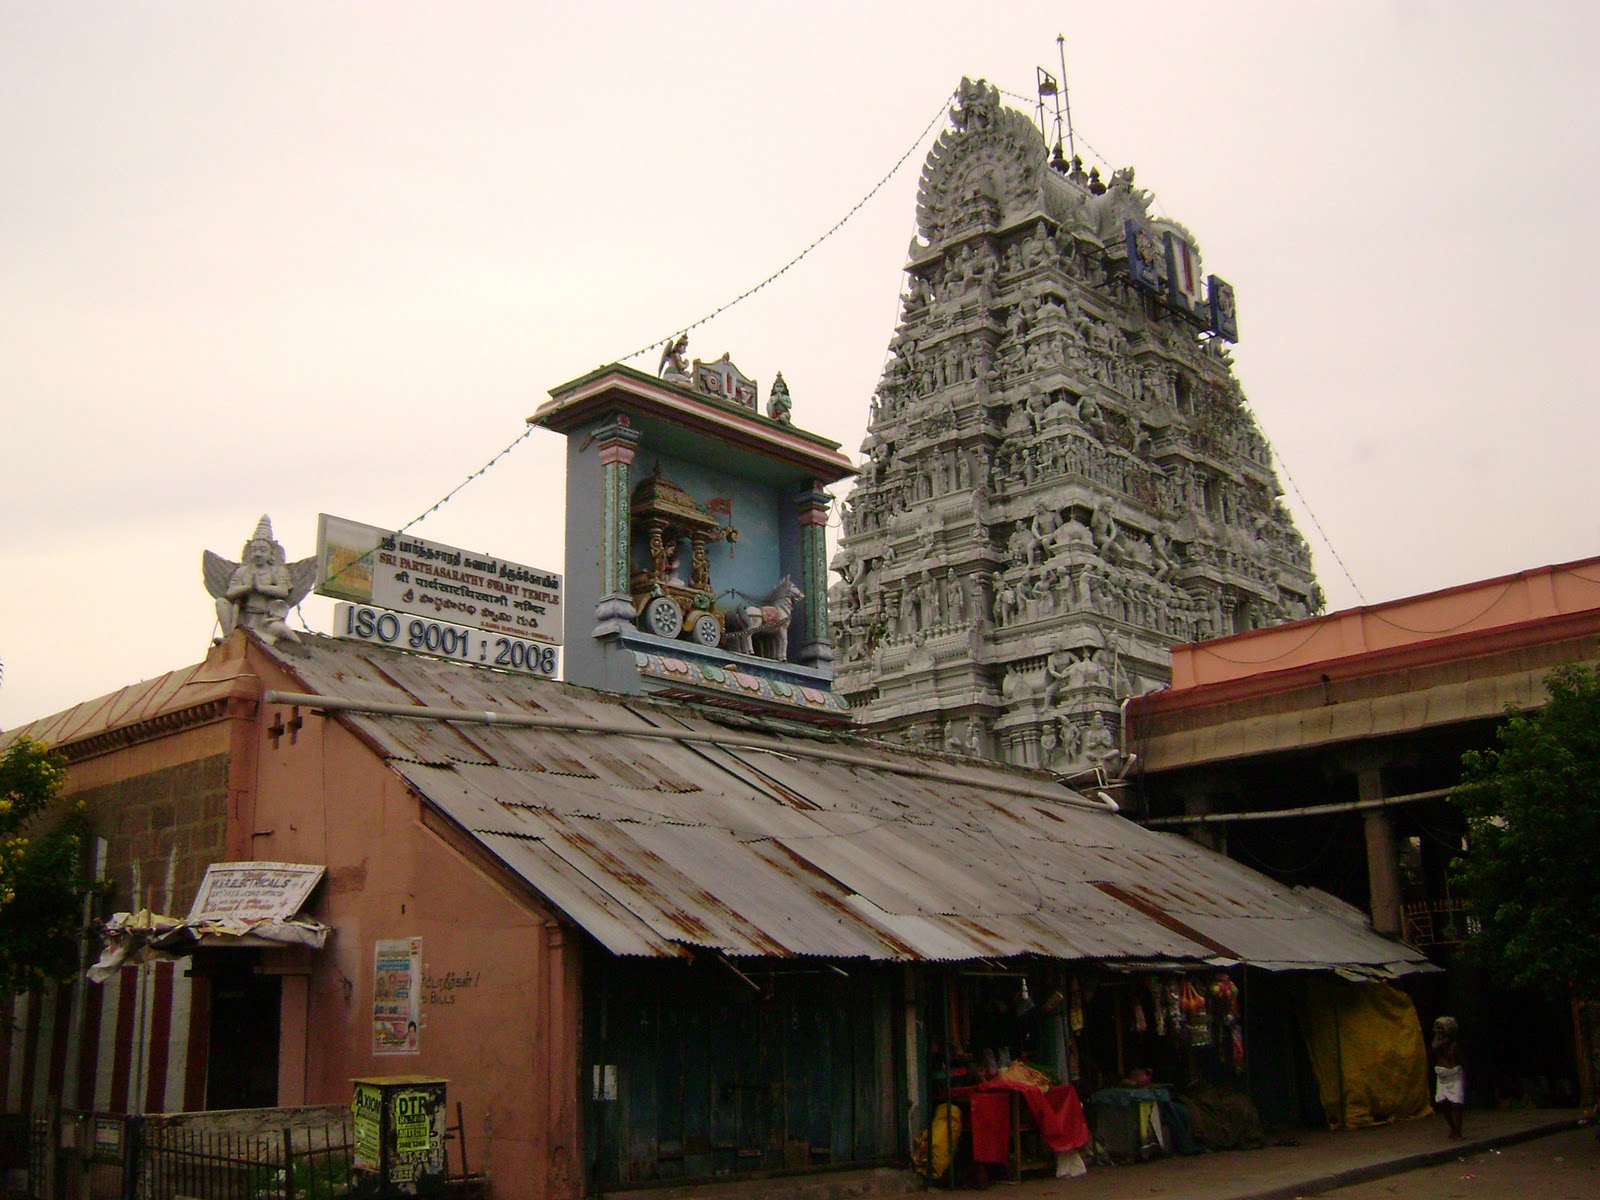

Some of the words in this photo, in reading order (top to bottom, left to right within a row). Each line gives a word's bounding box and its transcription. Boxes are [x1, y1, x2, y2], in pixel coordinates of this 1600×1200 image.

[379, 552, 397, 566] SRI
[399, 557, 485, 587] PARTHASARATHY
[487, 578, 520, 596] SWAMY
[521, 588, 559, 605] TEMPLE
[347, 605, 400, 642] ISO
[409, 619, 469, 658] 9001
[495, 638, 556, 674] 2008
[430, 991, 455, 1004] BILLS
